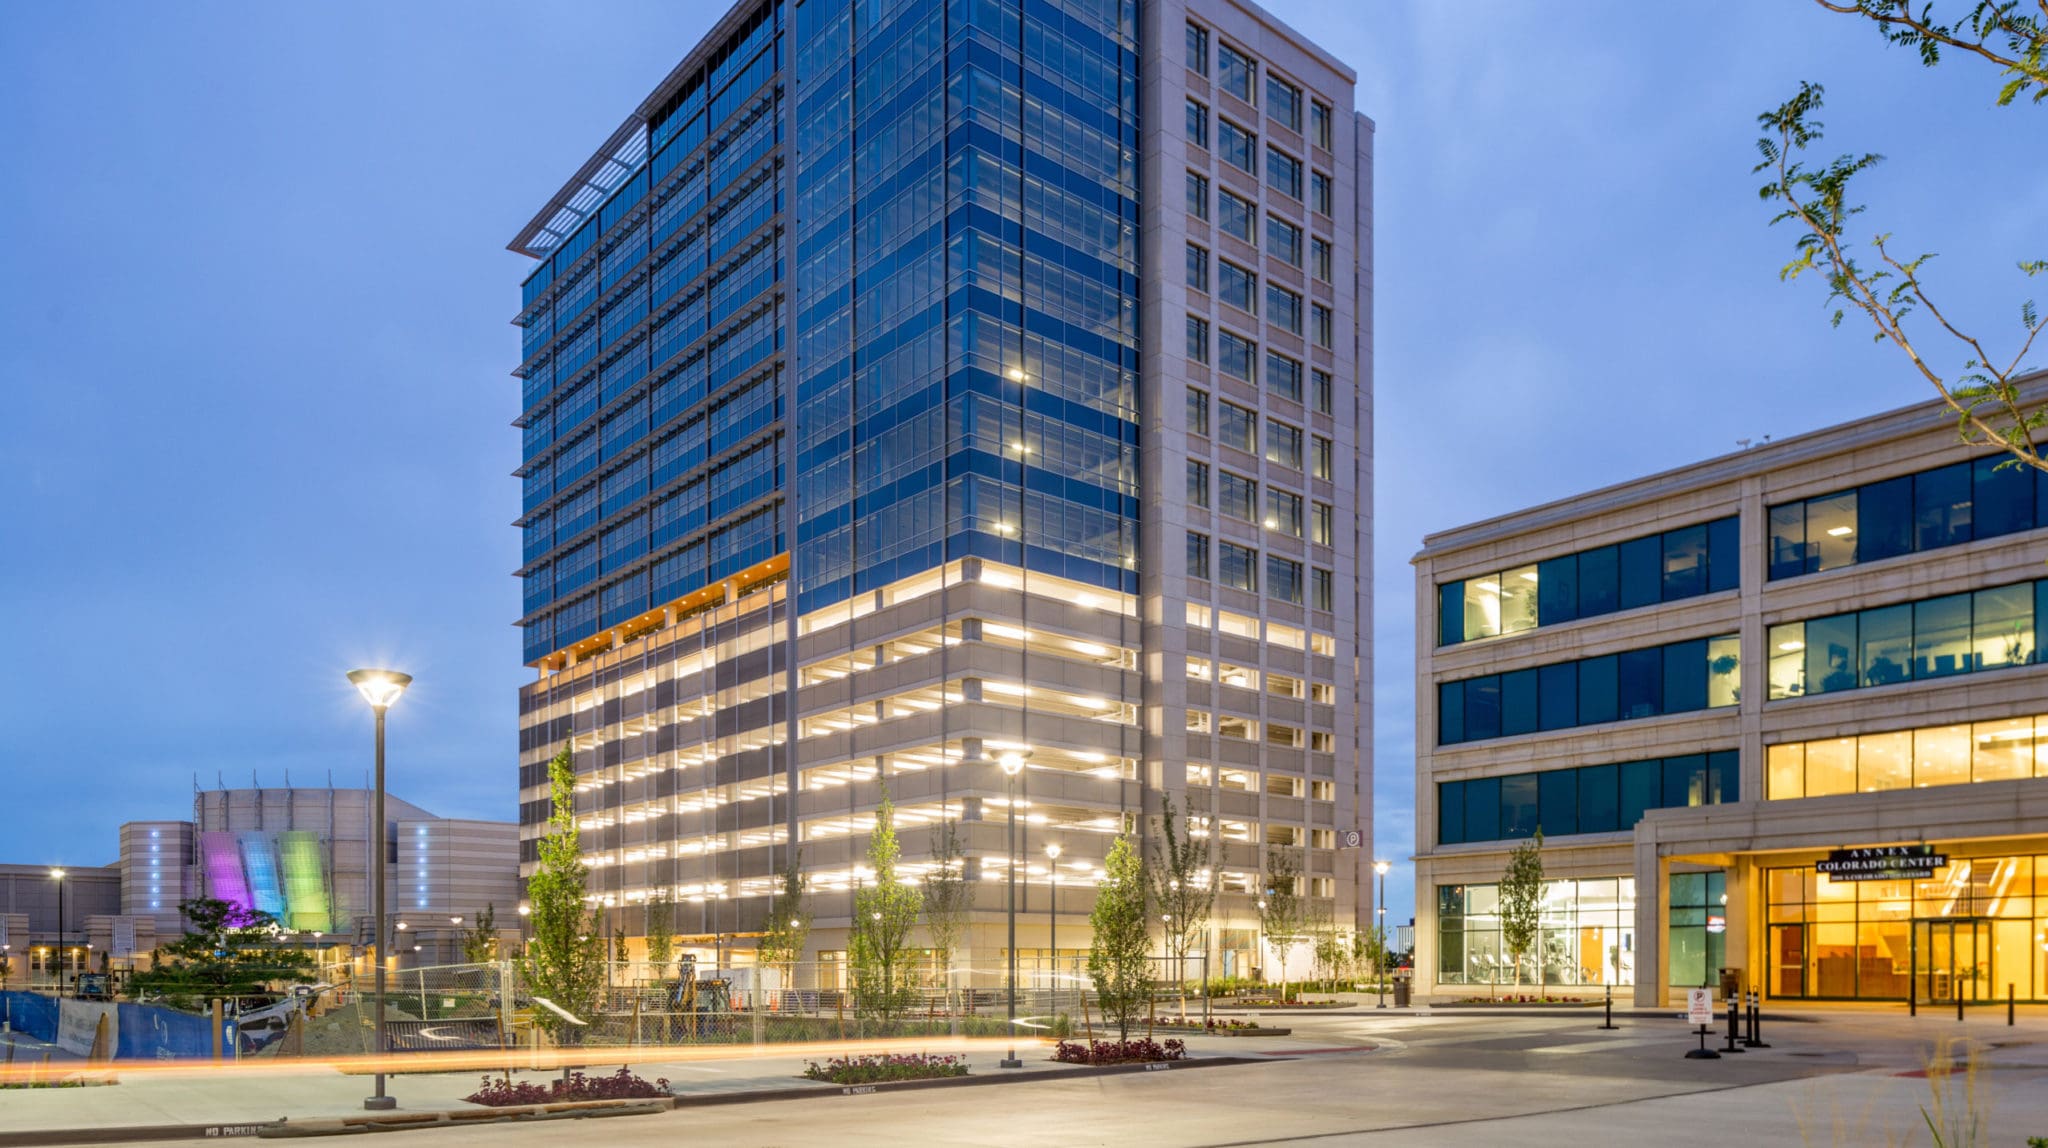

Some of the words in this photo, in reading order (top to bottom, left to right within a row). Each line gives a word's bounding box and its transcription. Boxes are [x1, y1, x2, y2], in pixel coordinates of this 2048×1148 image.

[1851, 847, 1909, 858] ANNEX
[1817, 859, 1887, 871] COLORADO
[1890, 856, 1944, 869] CENTER
[205, 1127, 219, 1137] NO
